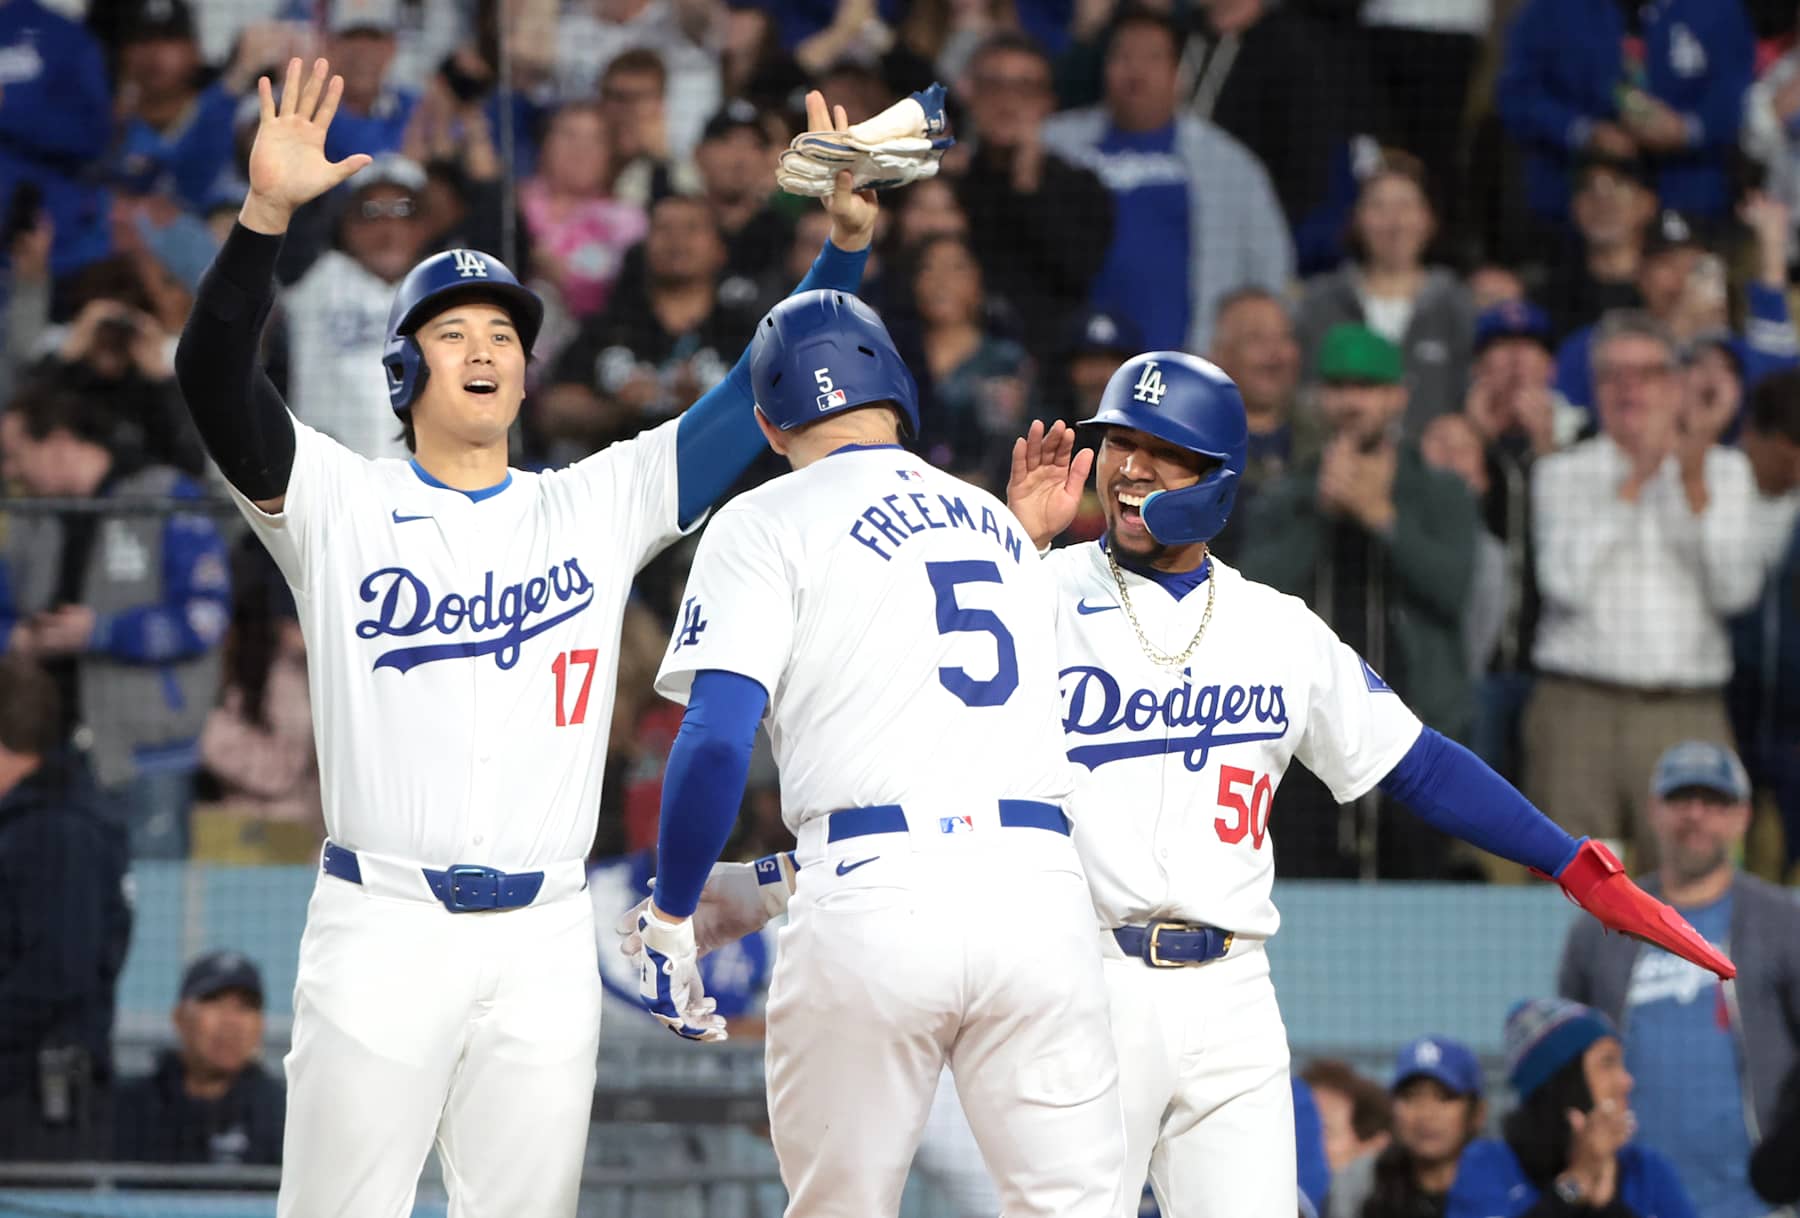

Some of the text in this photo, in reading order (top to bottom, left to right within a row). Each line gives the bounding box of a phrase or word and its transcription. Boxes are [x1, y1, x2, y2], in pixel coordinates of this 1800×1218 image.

[451, 248, 488, 278] LA
[814, 367, 834, 394] 5
[1133, 360, 1167, 406] LA
[849, 493, 1022, 564] FREEMAN
[355, 557, 595, 673] Dodgers
[673, 594, 708, 655] LA
[925, 559, 1019, 708] 5
[551, 648, 599, 727] 17
[1058, 666, 1289, 773] Dodgers
[1214, 764, 1273, 851] 50
[757, 860, 776, 873] 5
